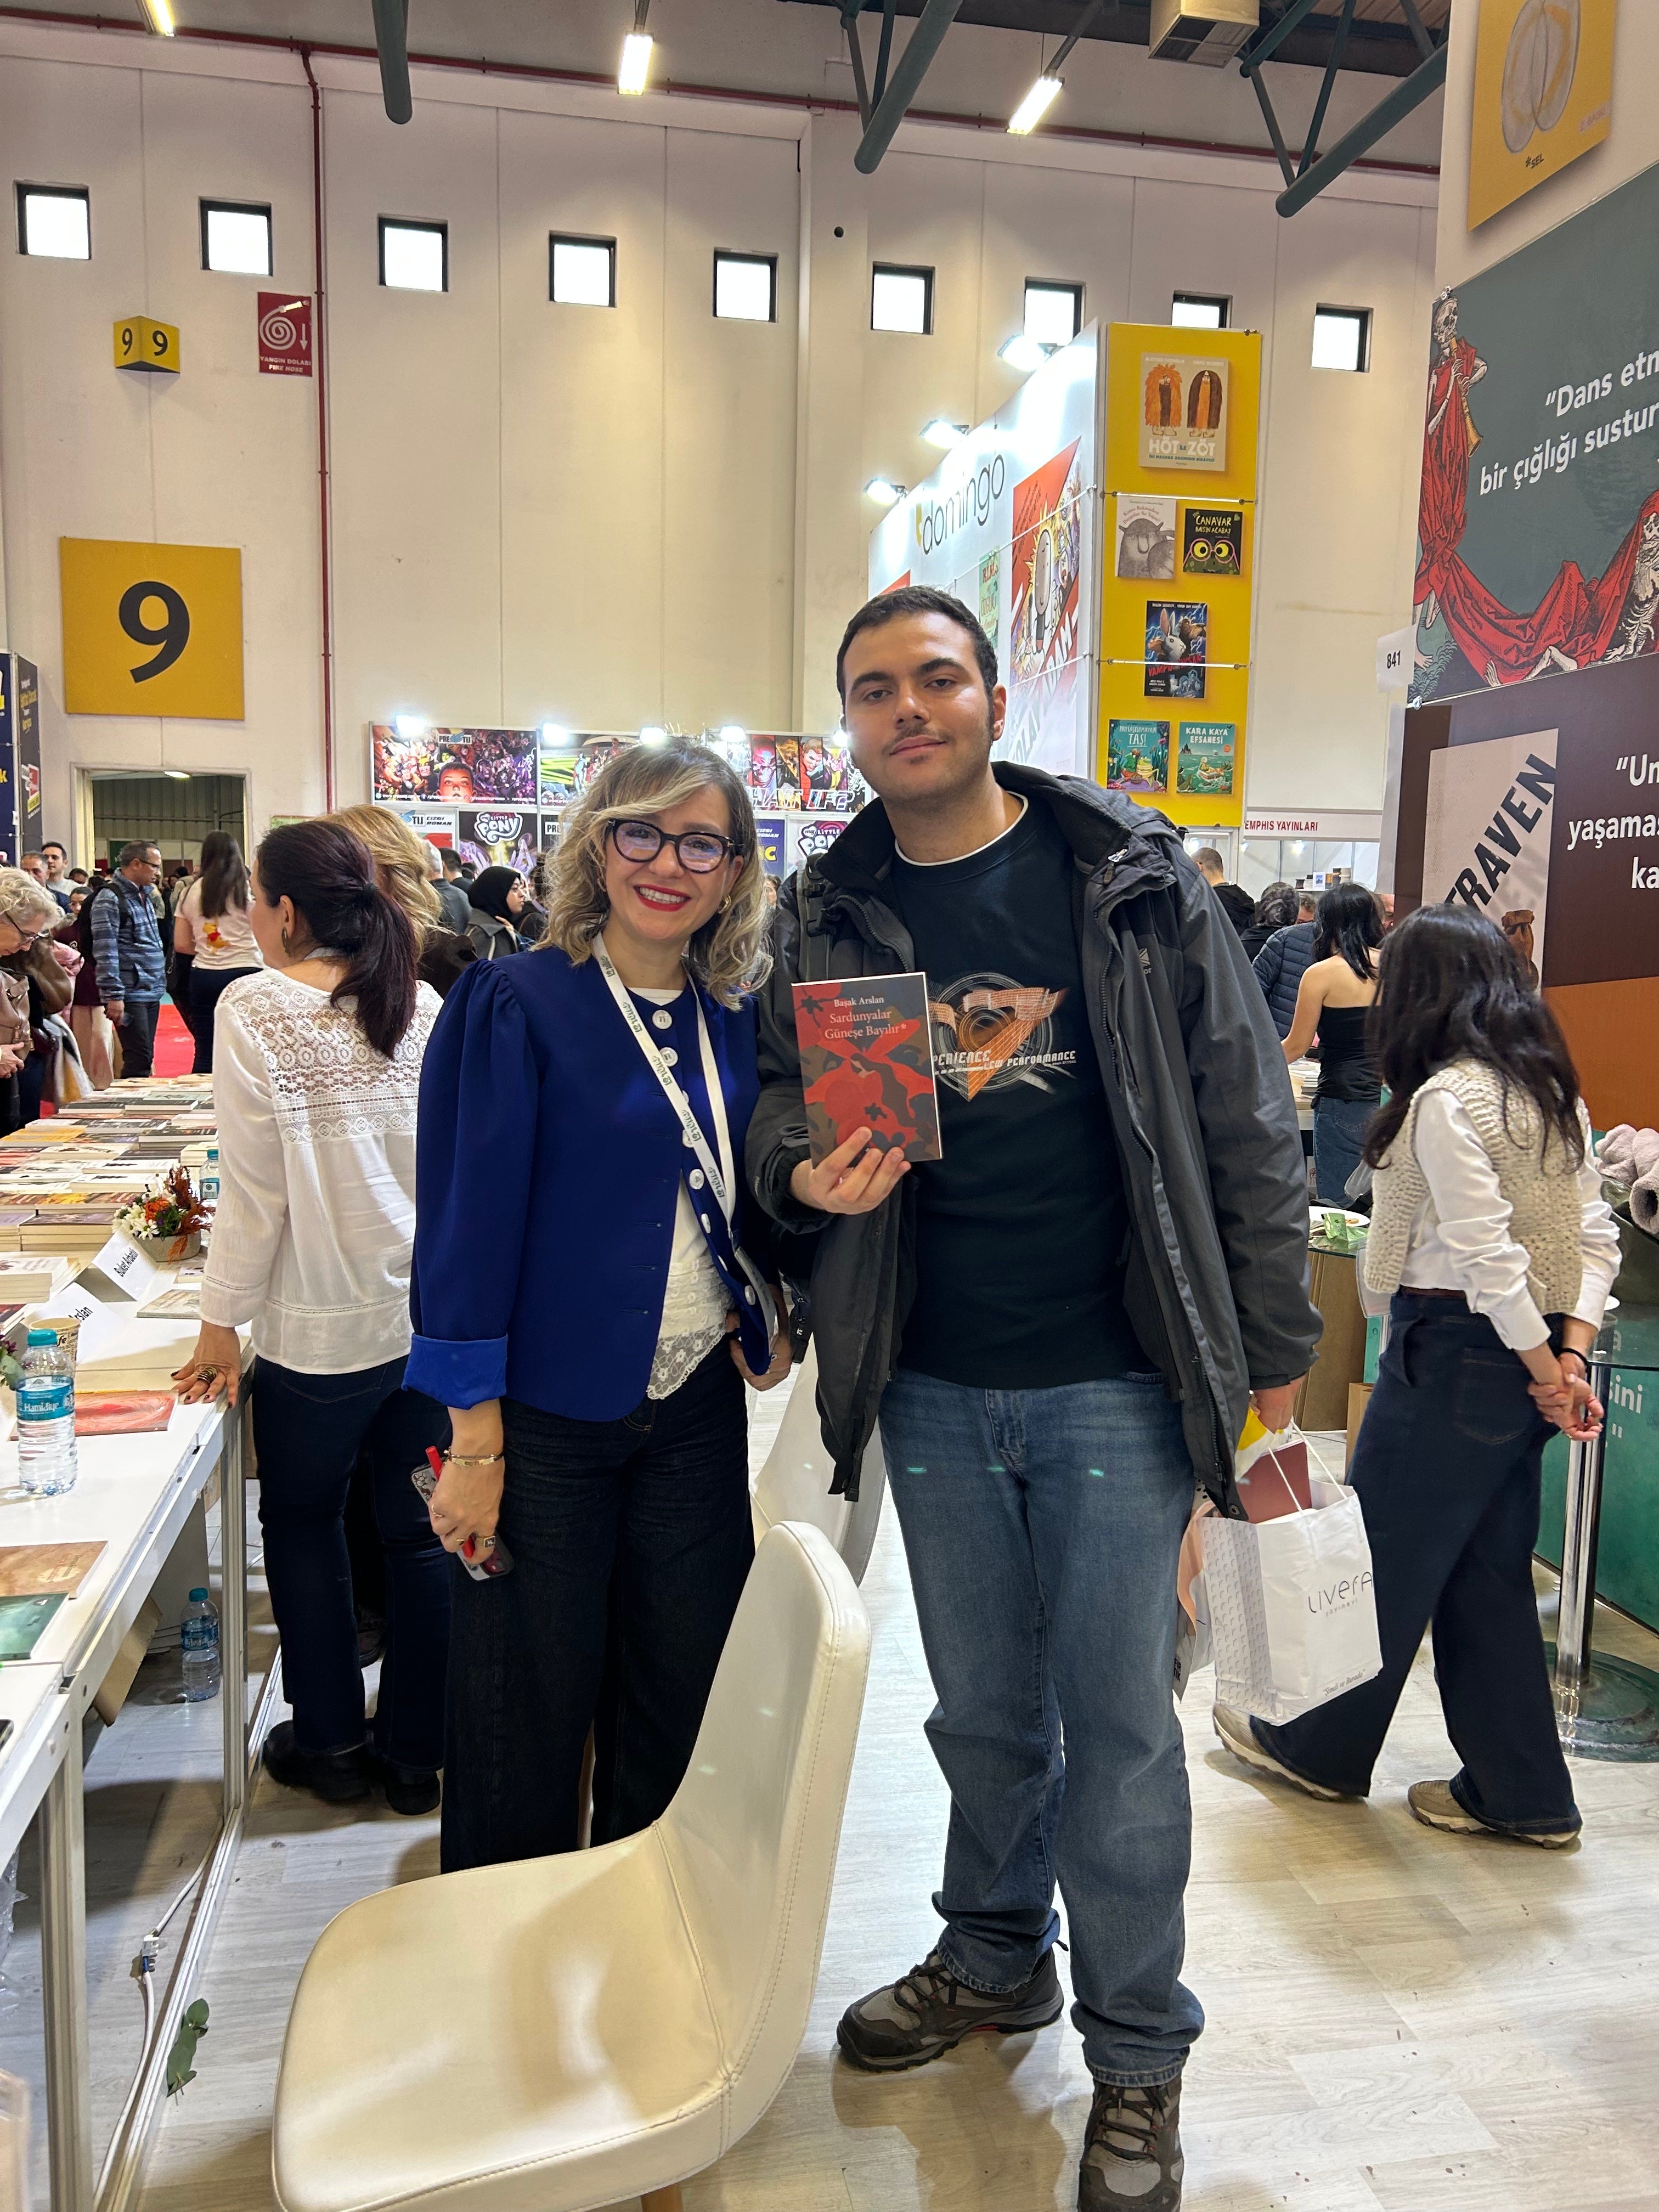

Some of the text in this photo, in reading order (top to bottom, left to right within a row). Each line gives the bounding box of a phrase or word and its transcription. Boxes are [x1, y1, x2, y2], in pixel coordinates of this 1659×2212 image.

[122, 328, 132, 356] 9
[152, 330, 168, 356] 9
[1479, 462, 1508, 495] bir
[1513, 432, 1577, 490] çığlığı
[922, 454, 1004, 555] domingo
[1195, 515, 1232, 527] CANAVAR
[119, 580, 190, 684] 9
[1386, 650, 1401, 669] 841
[1128, 733, 1147, 746] TAŞ!
[1186, 727, 1228, 736] KARA KAYA
[1190, 735, 1223, 744] EFSANESİ
[477, 817, 520, 842] PONY
[1245, 820, 1318, 832] EMPHIS YAYINLARI
[1567, 814, 1659, 850] yaşama
[834, 996, 884, 1008] Başak Arslan
[830, 1009, 891, 1024] Sardunyalar
[825, 1026, 864, 1040] Güneşe
[933, 1049, 991, 1065] PERIENCE
[1007, 1050, 1076, 1067] PERFORMANCE
